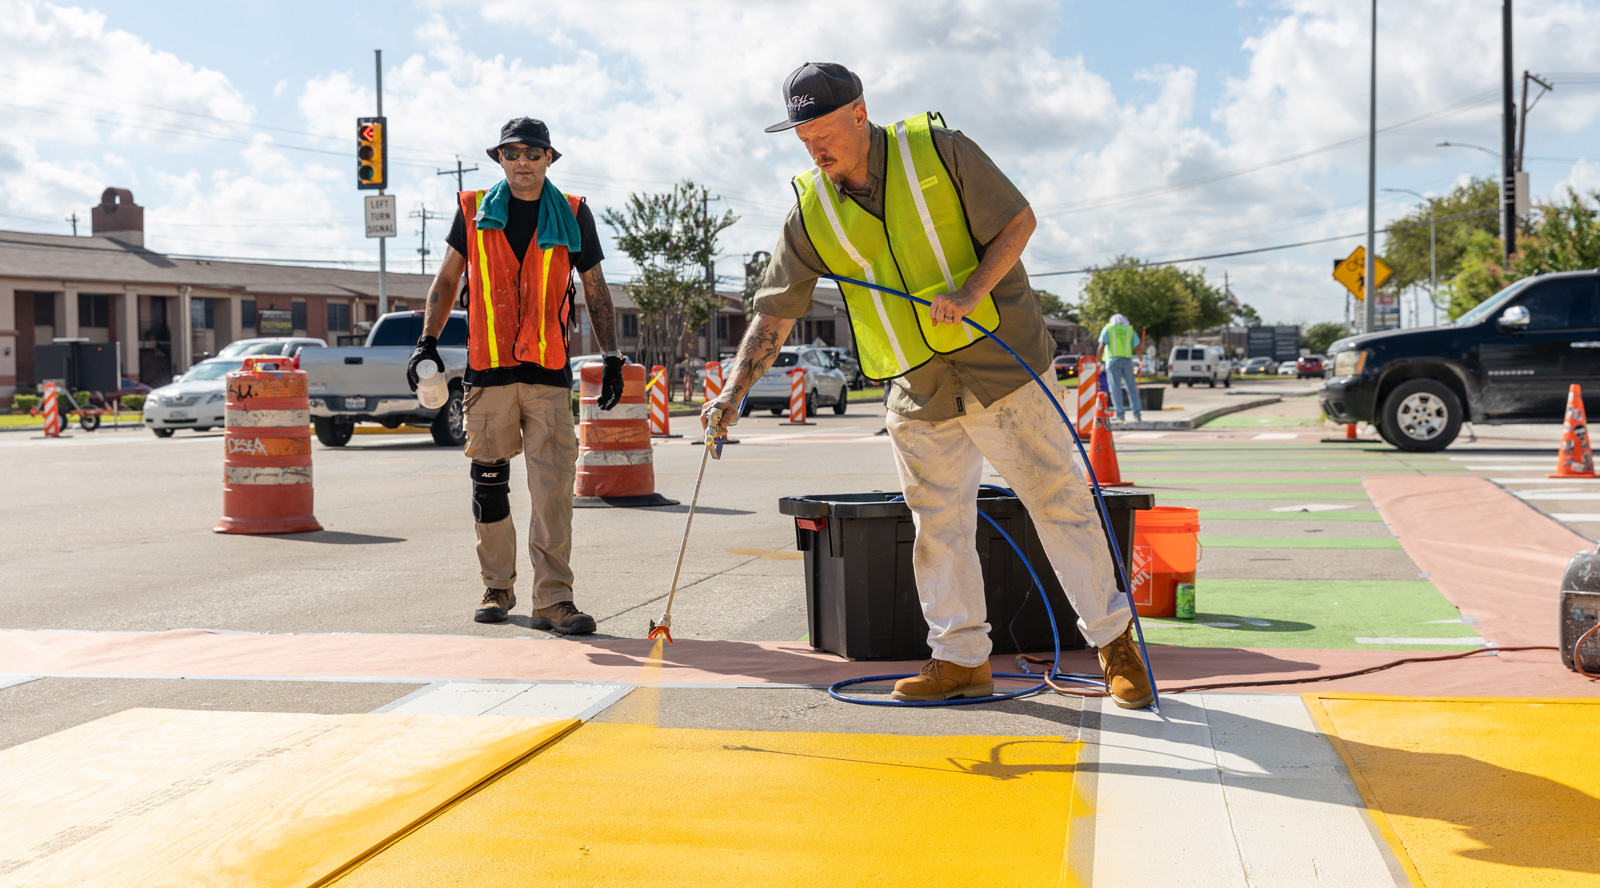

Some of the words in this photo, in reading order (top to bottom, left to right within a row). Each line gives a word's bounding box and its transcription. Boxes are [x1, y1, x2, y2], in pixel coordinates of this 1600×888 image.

[371, 200, 389, 209] LEFT
[371, 212, 391, 221] TURN
[368, 224, 394, 233] SIGNAL
